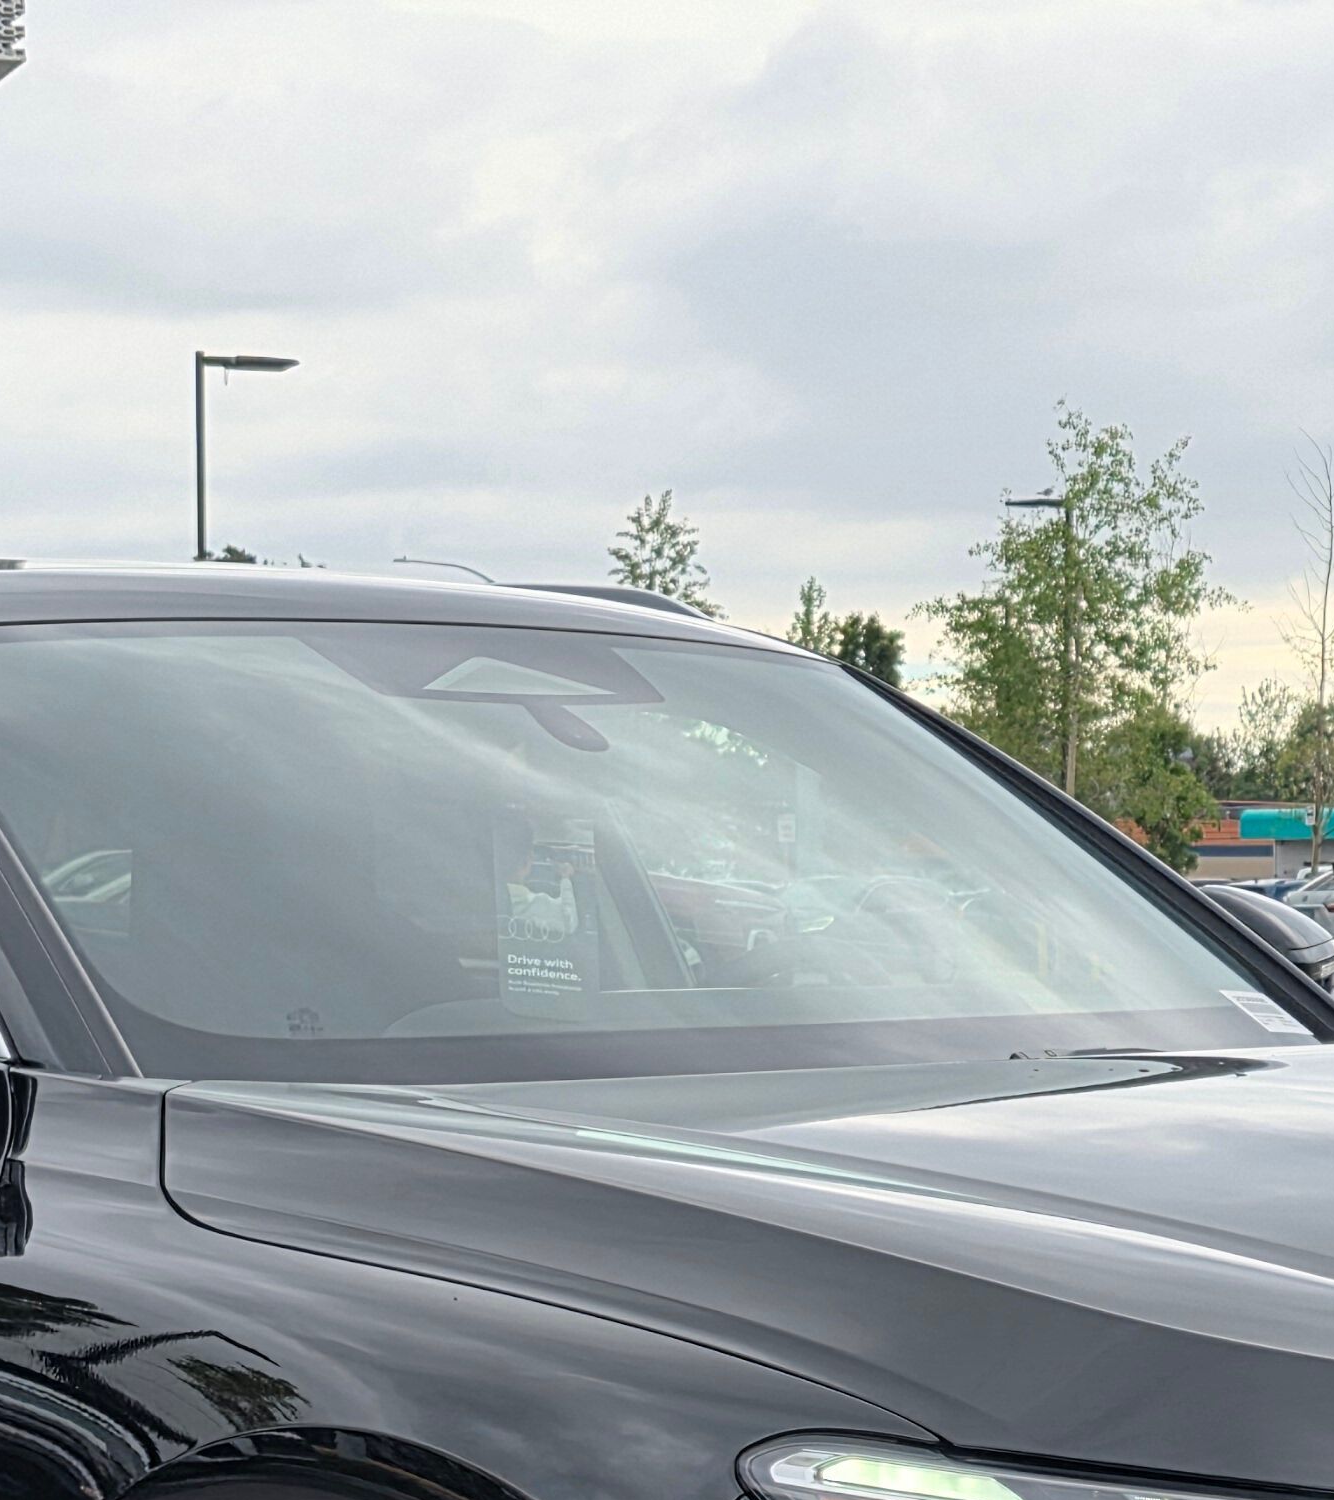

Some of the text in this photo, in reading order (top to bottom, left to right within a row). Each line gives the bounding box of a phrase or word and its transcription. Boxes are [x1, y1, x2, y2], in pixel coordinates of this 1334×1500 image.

[507, 954, 573, 969] Drive with
[508, 967, 582, 982] confidence.
